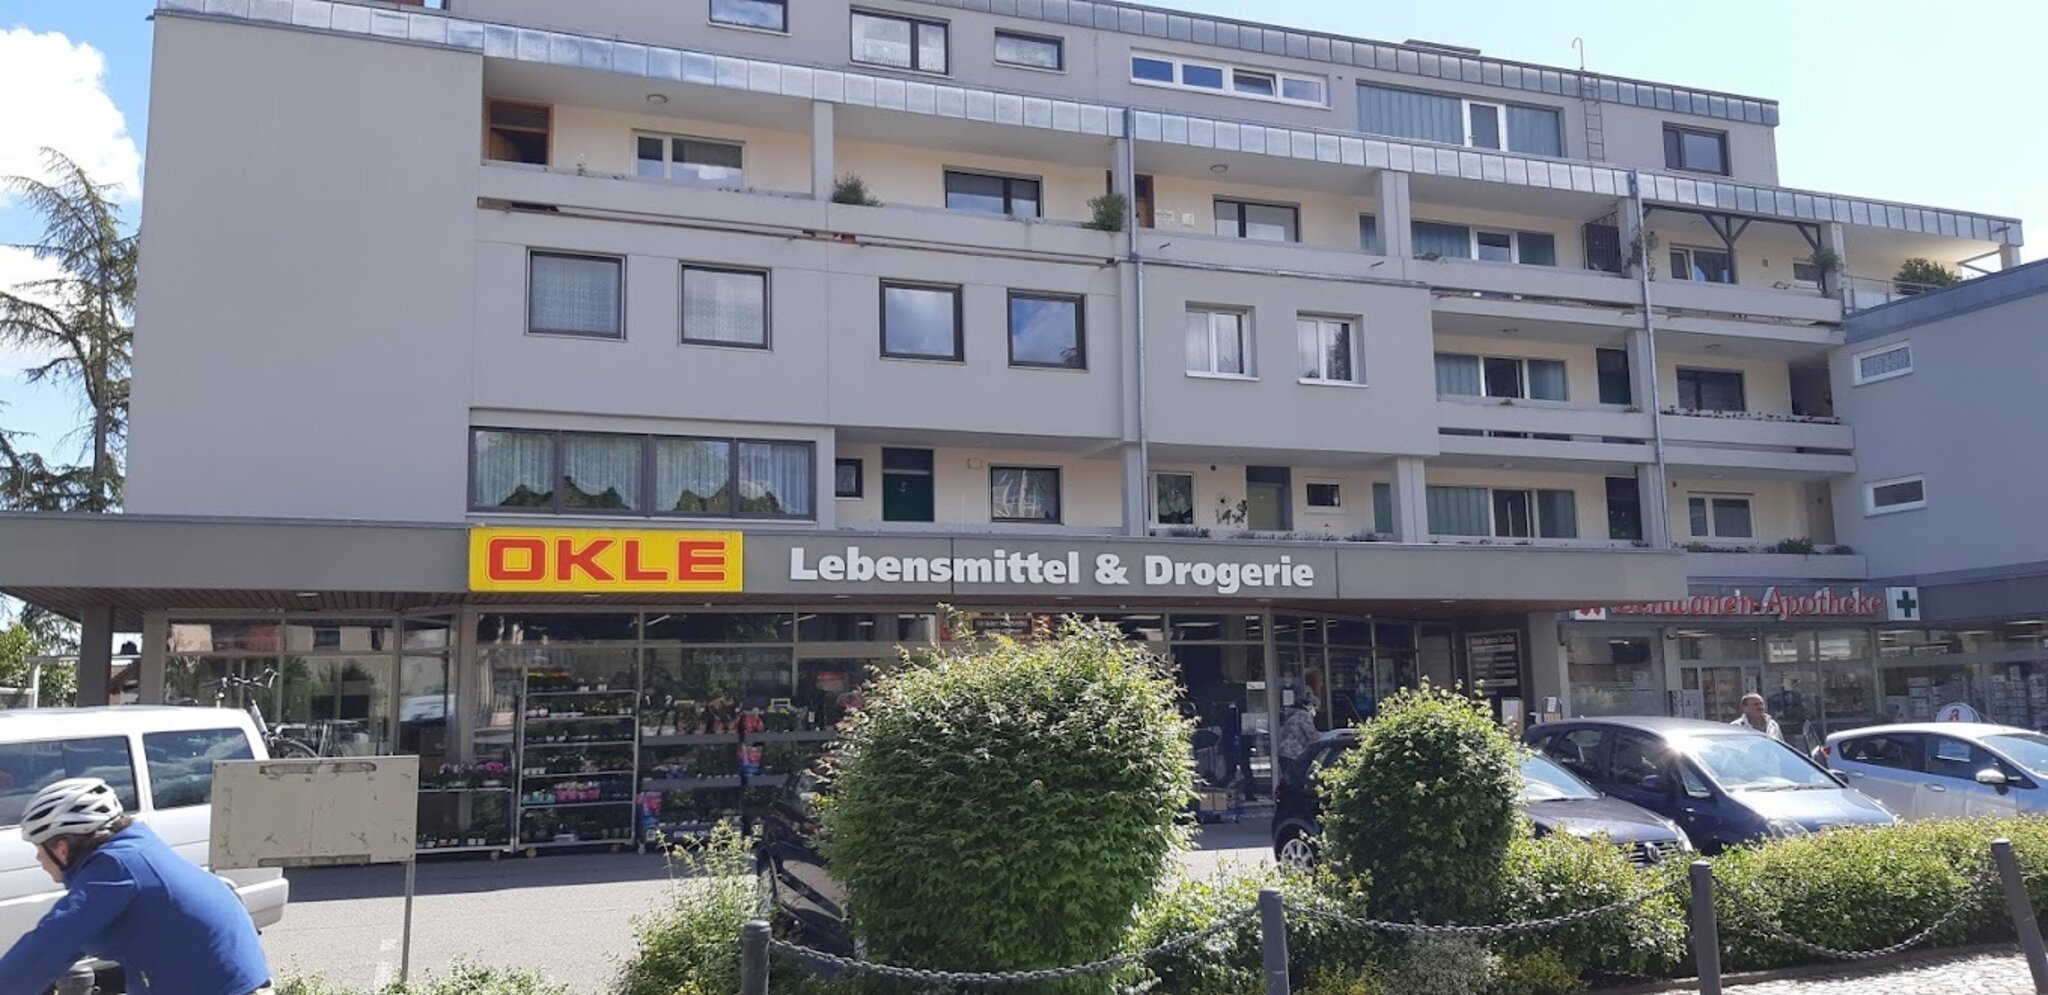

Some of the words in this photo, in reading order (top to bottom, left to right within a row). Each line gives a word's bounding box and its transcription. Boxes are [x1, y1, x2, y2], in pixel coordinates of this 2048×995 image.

[487, 537, 727, 582] OKLE
[789, 546, 1080, 584] Lebensmittel
[1094, 553, 1130, 585] &
[1144, 554, 1315, 594] Drogerie
